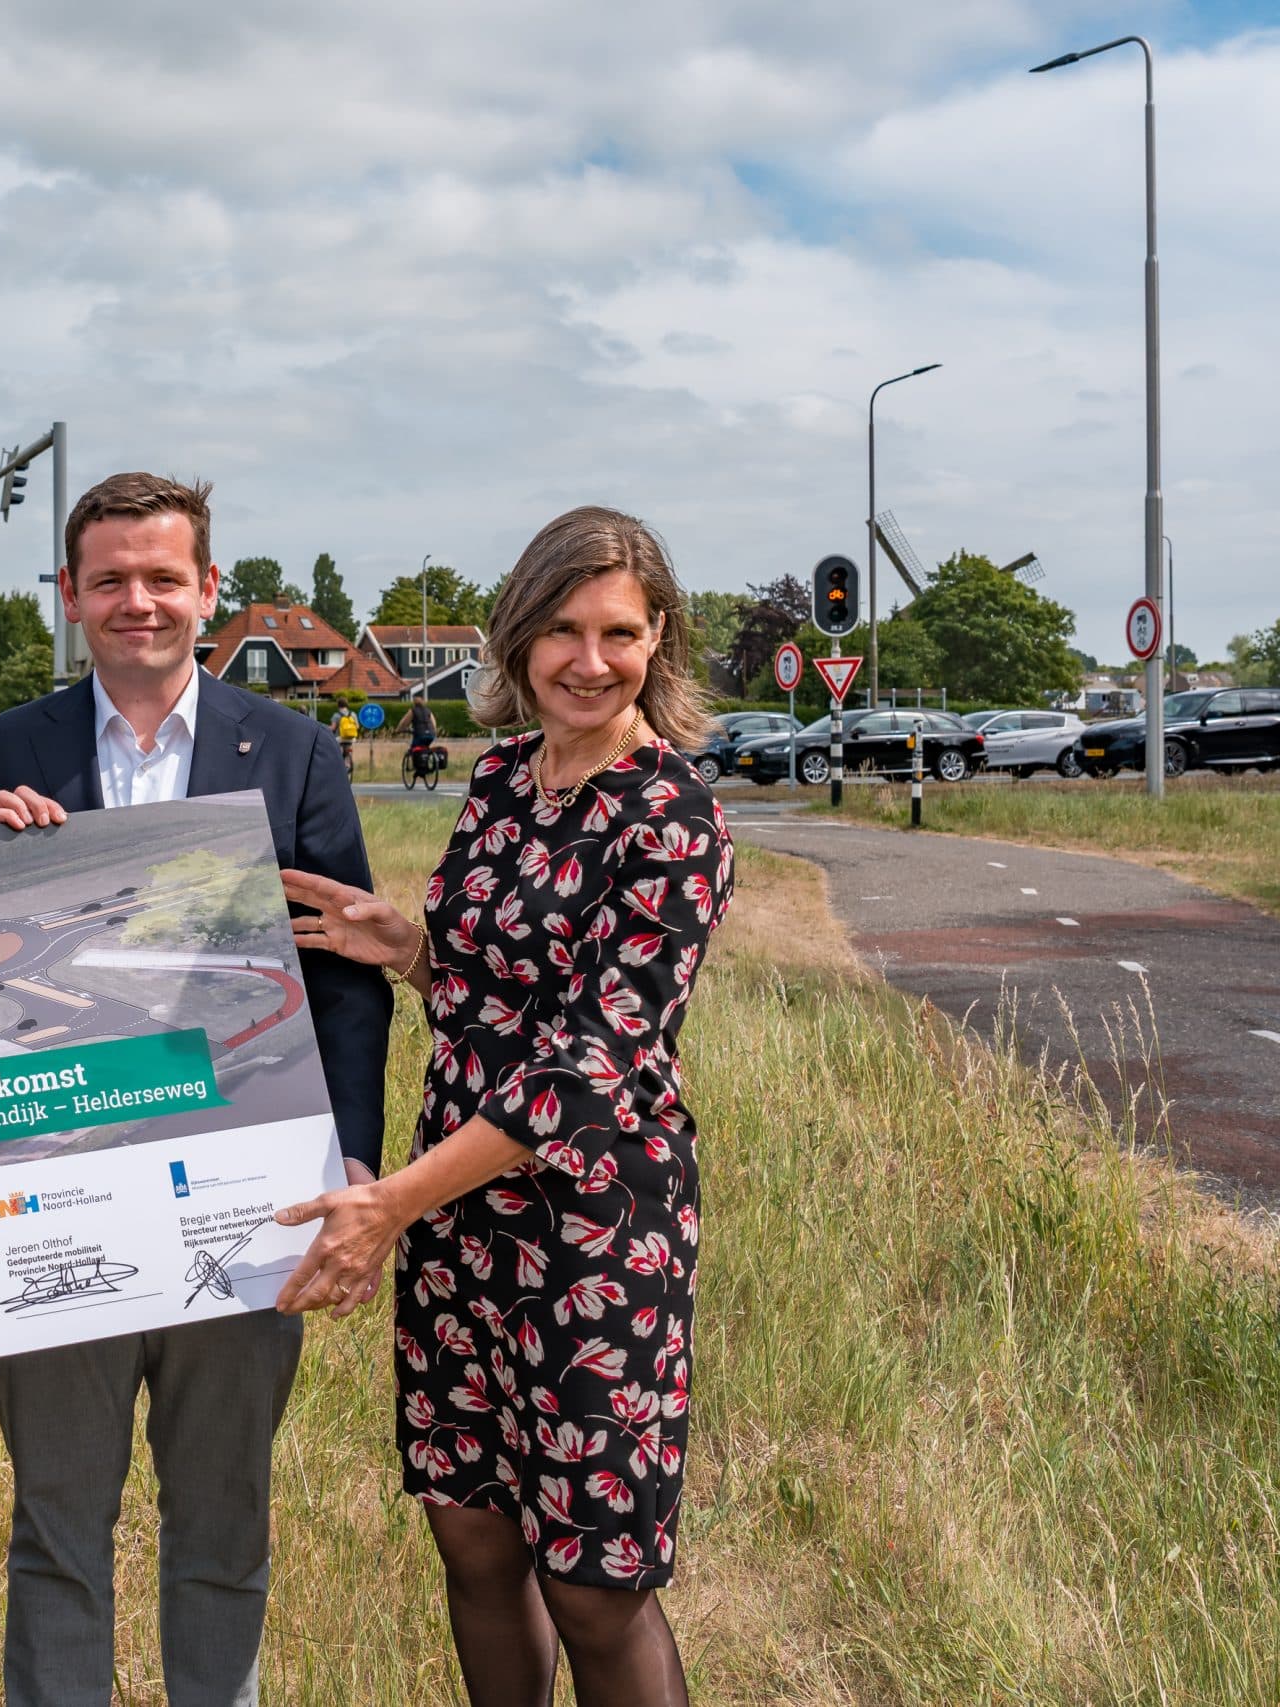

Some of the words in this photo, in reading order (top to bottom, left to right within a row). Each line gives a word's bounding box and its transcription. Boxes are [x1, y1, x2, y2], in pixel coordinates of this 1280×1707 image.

[72, 1078, 208, 1114] Helderseweg
[41, 1186, 84, 1201] Provincie
[42, 1192, 113, 1211] Noord-Holland
[180, 1212, 211, 1227] Bregje
[214, 1211, 231, 1220] van
[233, 1202, 274, 1217] Beekvelt
[182, 1225, 217, 1237] Directeur
[184, 1231, 245, 1248] Rijkswaterstaat
[5, 1244, 40, 1257] Jeroen
[42, 1235, 73, 1250] Olthof
[7, 1251, 63, 1267] Gedeputeerde
[65, 1244, 102, 1258] mobiliteit
[9, 1265, 46, 1278] Provincie
[48, 1255, 106, 1271] Noord-Holland
